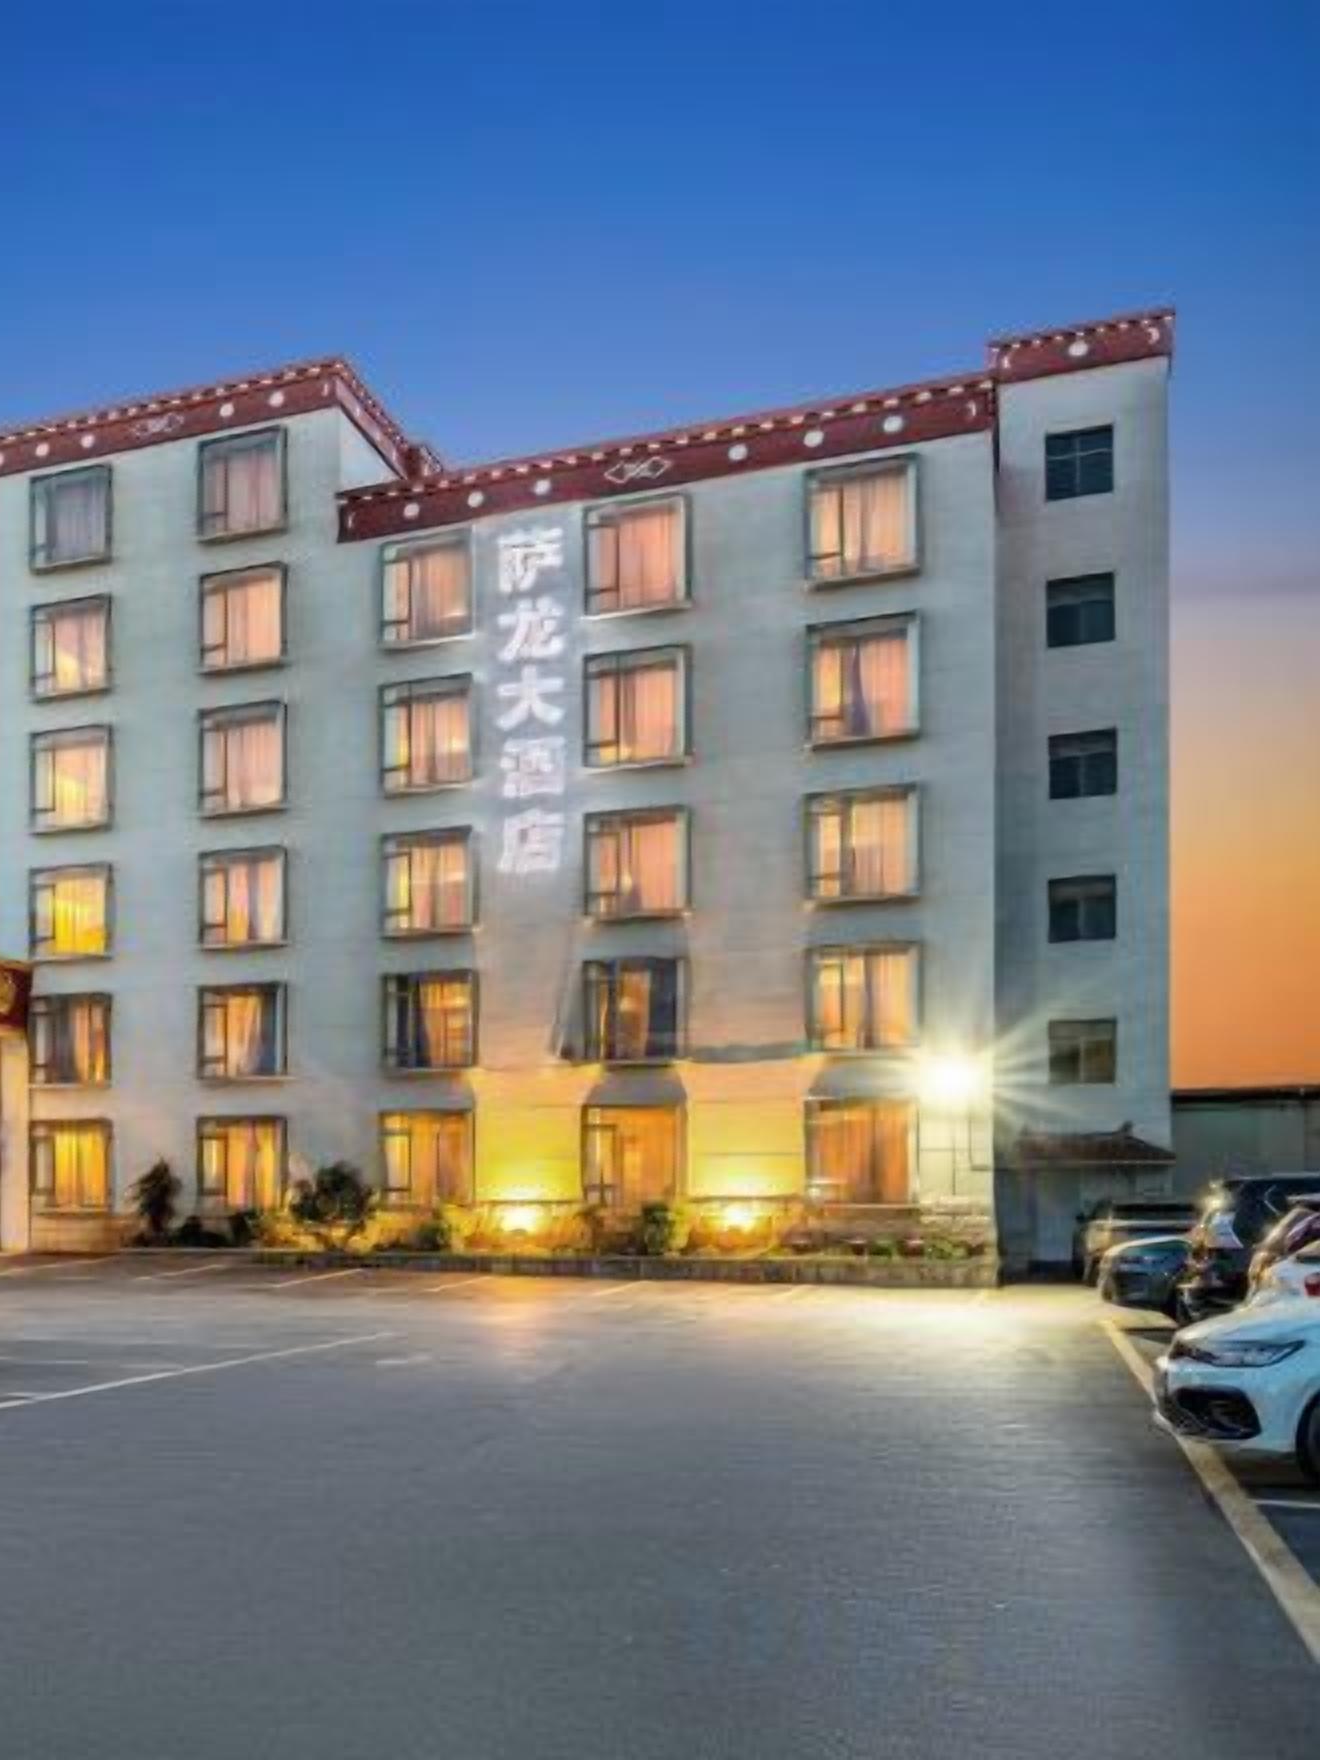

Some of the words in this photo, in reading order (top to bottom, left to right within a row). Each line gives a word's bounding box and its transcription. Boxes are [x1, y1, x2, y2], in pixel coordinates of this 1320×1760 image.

[497, 527, 565, 874] 萨龙大酒店
